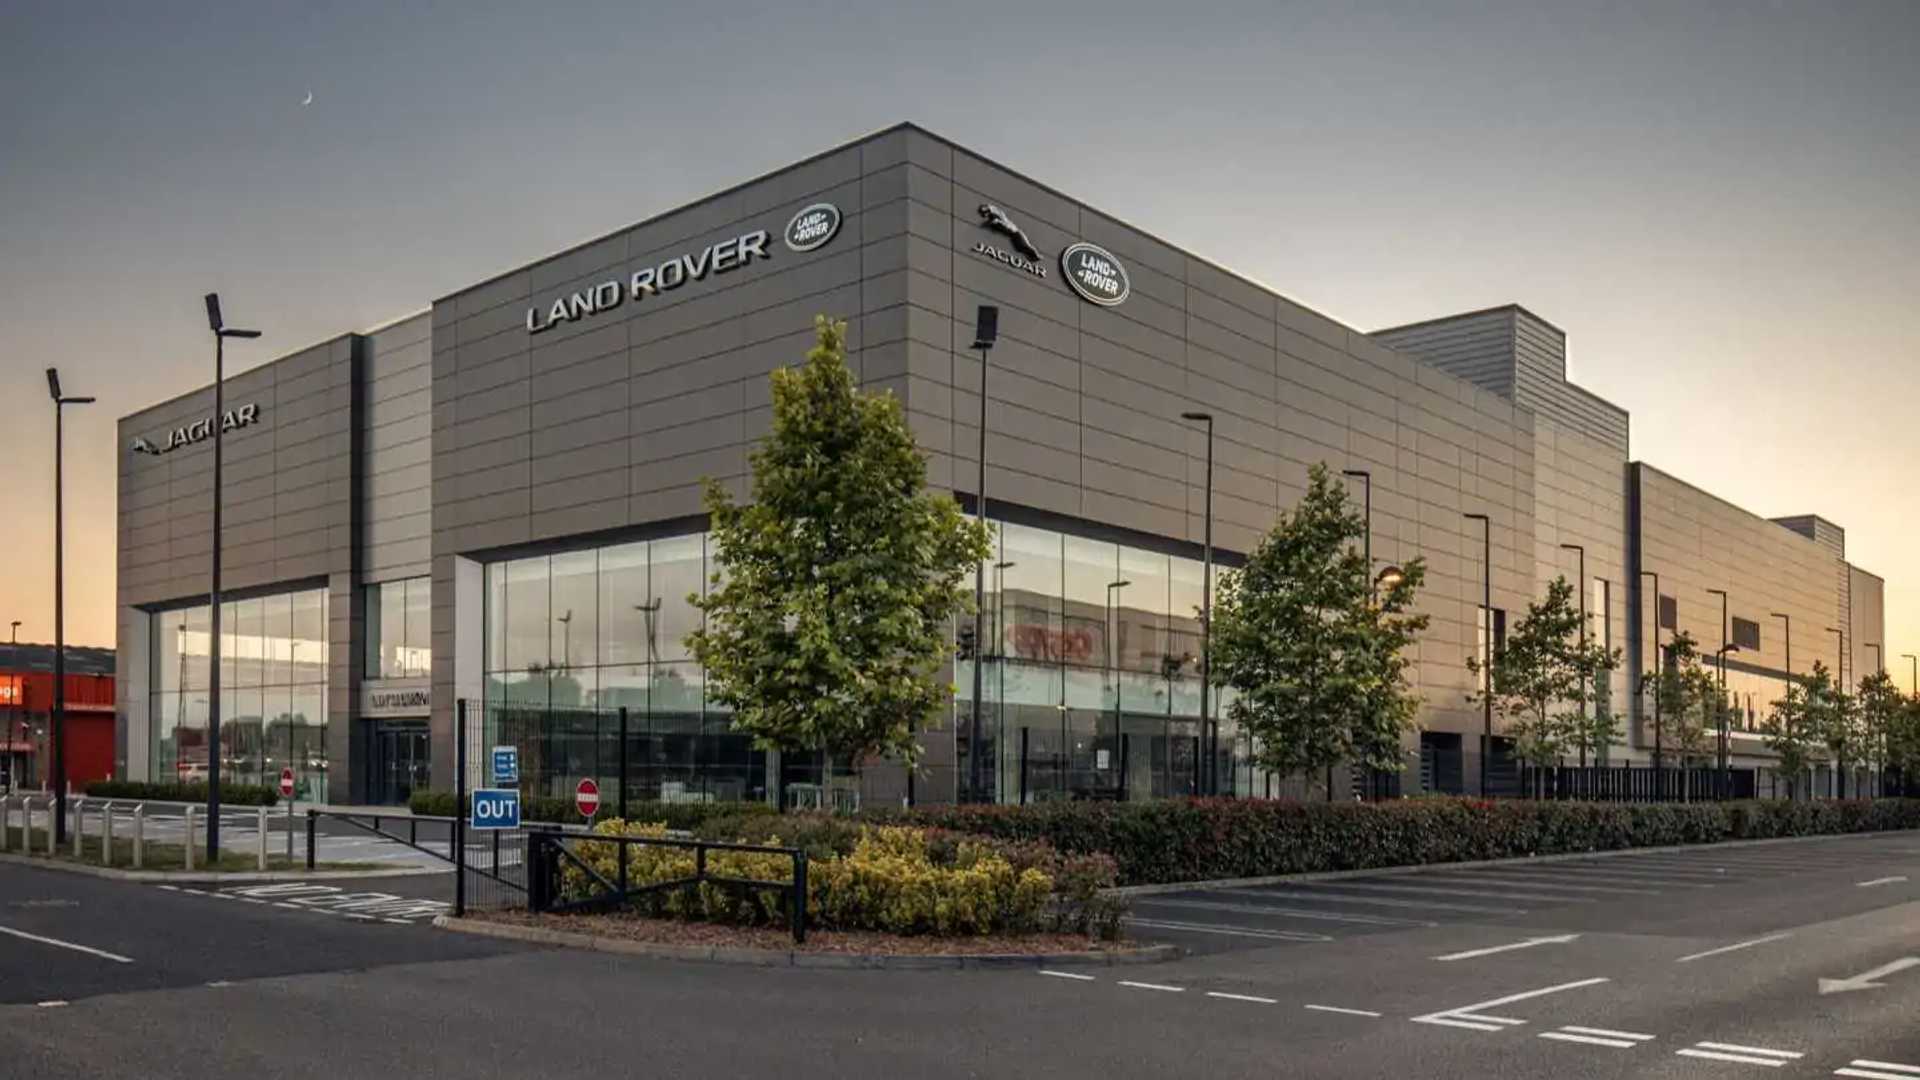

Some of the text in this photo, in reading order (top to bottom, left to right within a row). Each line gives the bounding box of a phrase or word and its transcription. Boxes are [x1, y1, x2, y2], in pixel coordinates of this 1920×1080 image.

[797, 213, 822, 230] LAND
[799, 222, 829, 241] ROVER
[974, 242, 1047, 277] JAGUAR
[1081, 254, 1110, 276] LAND
[526, 230, 770, 333] LAND ROVER
[1084, 270, 1118, 296] ROVER
[476, 800, 515, 818] OUT
